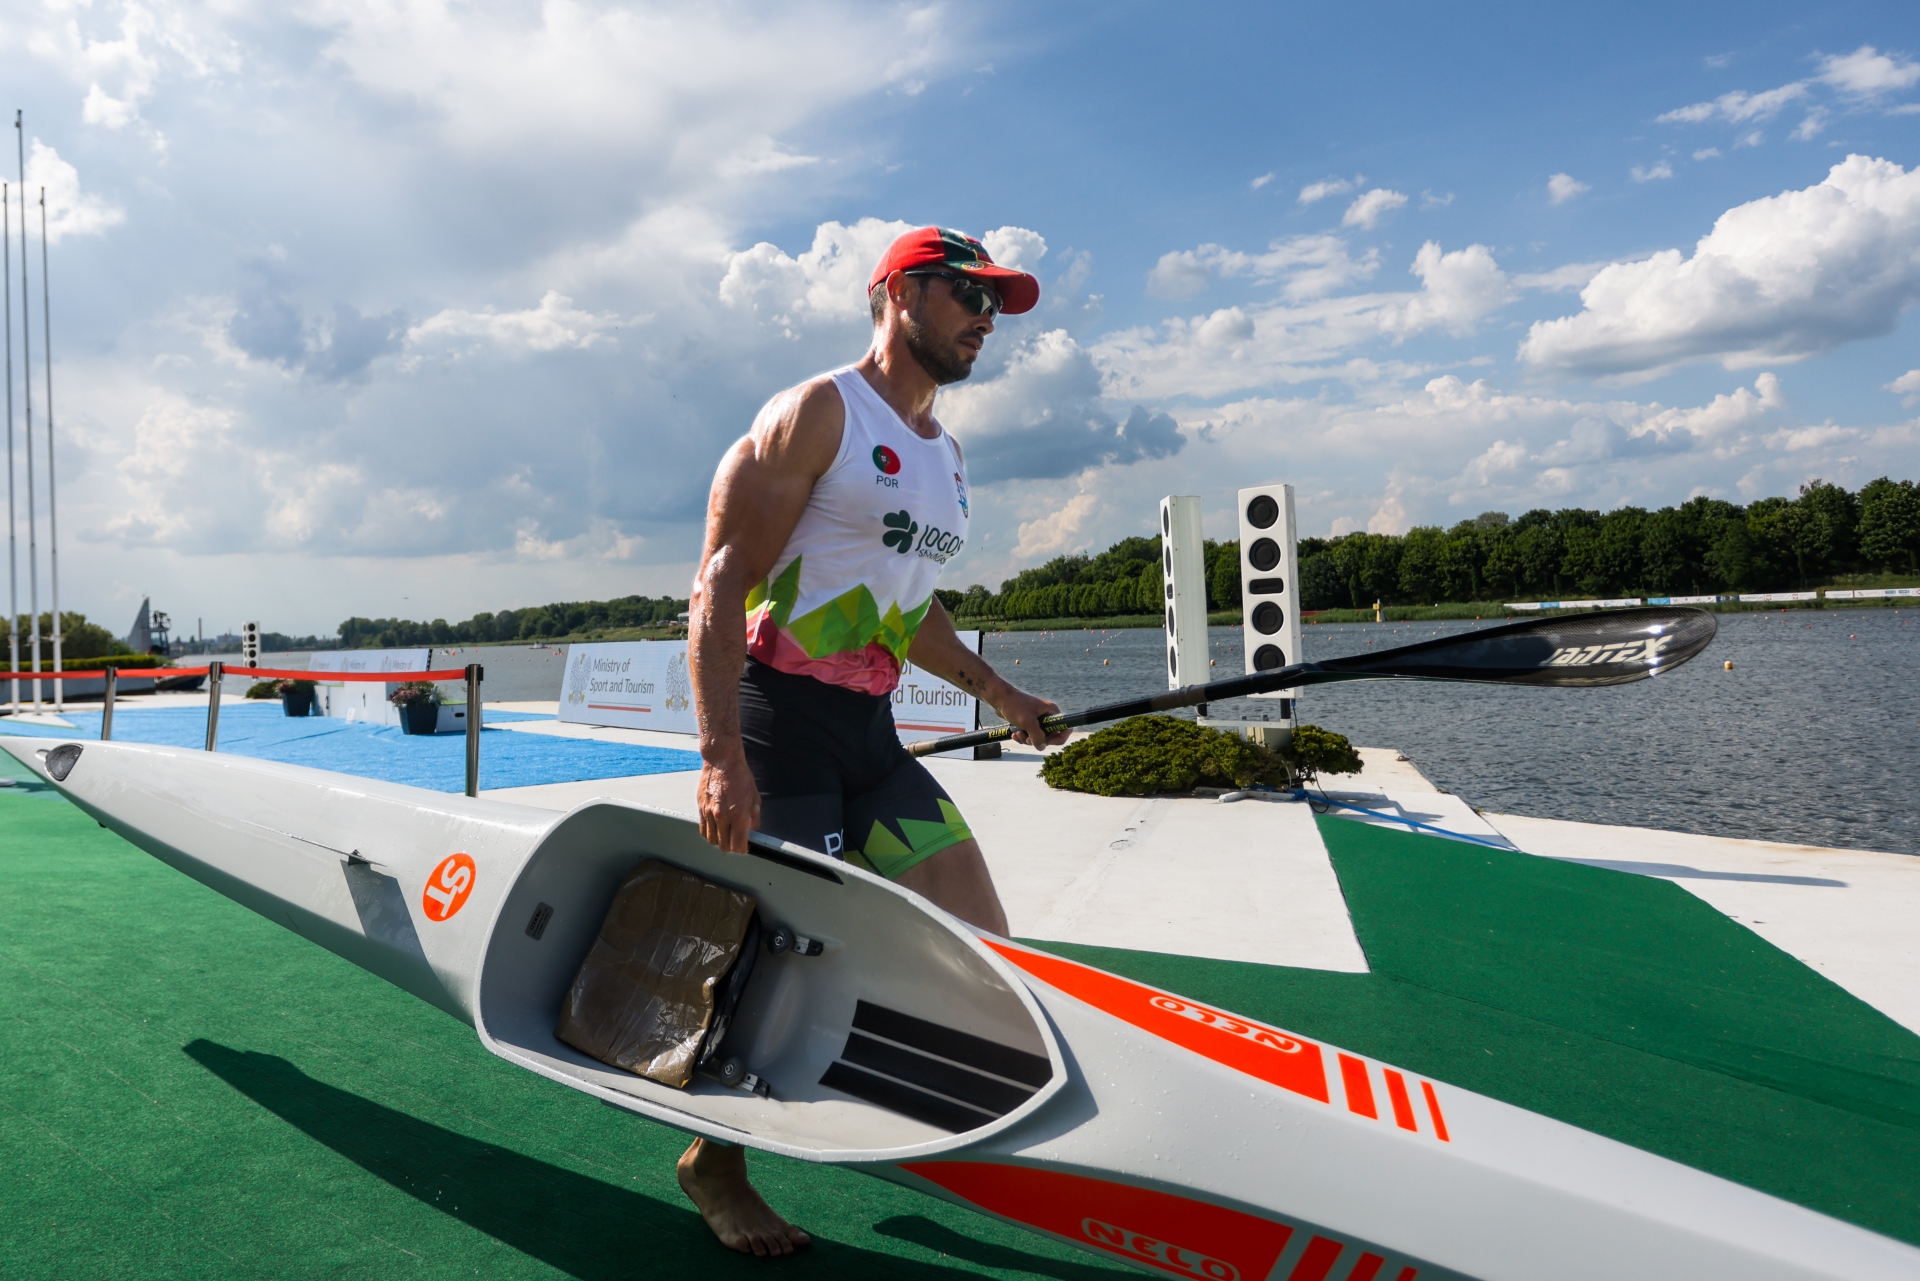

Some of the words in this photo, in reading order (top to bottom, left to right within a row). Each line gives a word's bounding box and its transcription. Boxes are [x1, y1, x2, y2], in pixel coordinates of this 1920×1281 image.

[876, 475, 899, 489] POR
[592, 659, 621, 675] Ministry
[622, 658, 631, 672] of
[590, 678, 608, 694] Sport
[609, 678, 623, 693] and
[624, 679, 655, 694] Tourism
[907, 683, 967, 707] Tourism
[1152, 997, 1300, 1053] NELO
[1083, 1218, 1239, 1281] NELO
